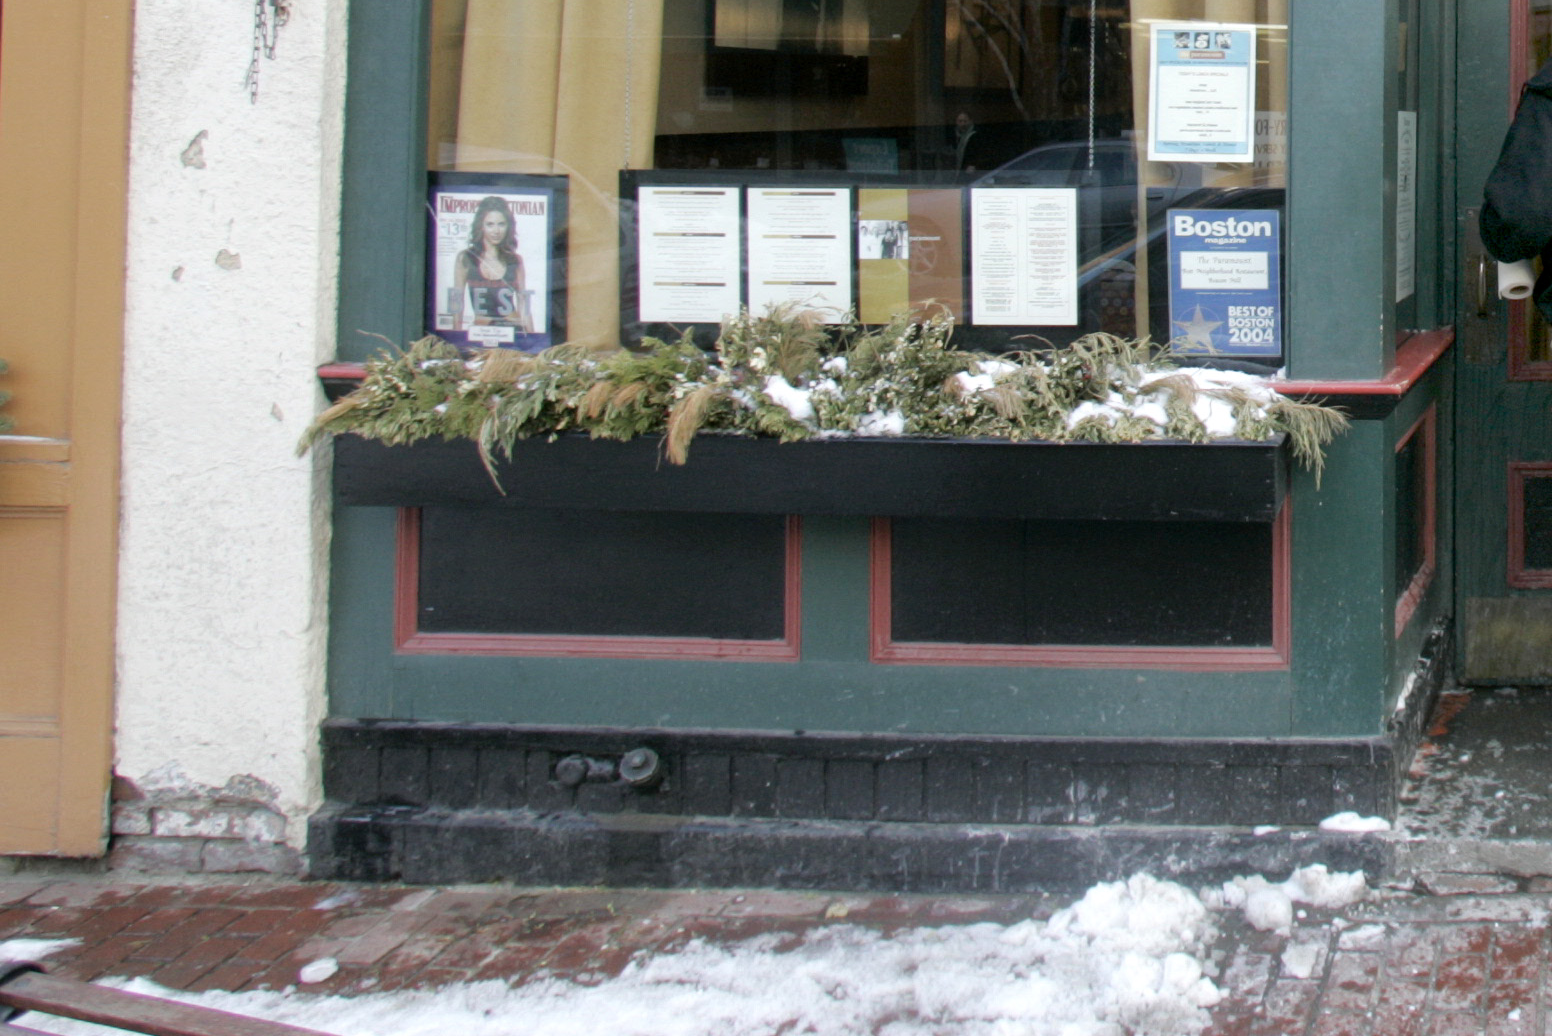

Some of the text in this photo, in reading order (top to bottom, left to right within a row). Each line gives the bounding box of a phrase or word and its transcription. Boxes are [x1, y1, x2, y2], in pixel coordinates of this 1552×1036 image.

[1174, 215, 1272, 237] Boston
[1204, 237, 1247, 245] magazine
[1228, 306, 1275, 316] BEST OF
[1228, 318, 1275, 327] BOSTON
[1228, 328, 1275, 343] 2004
